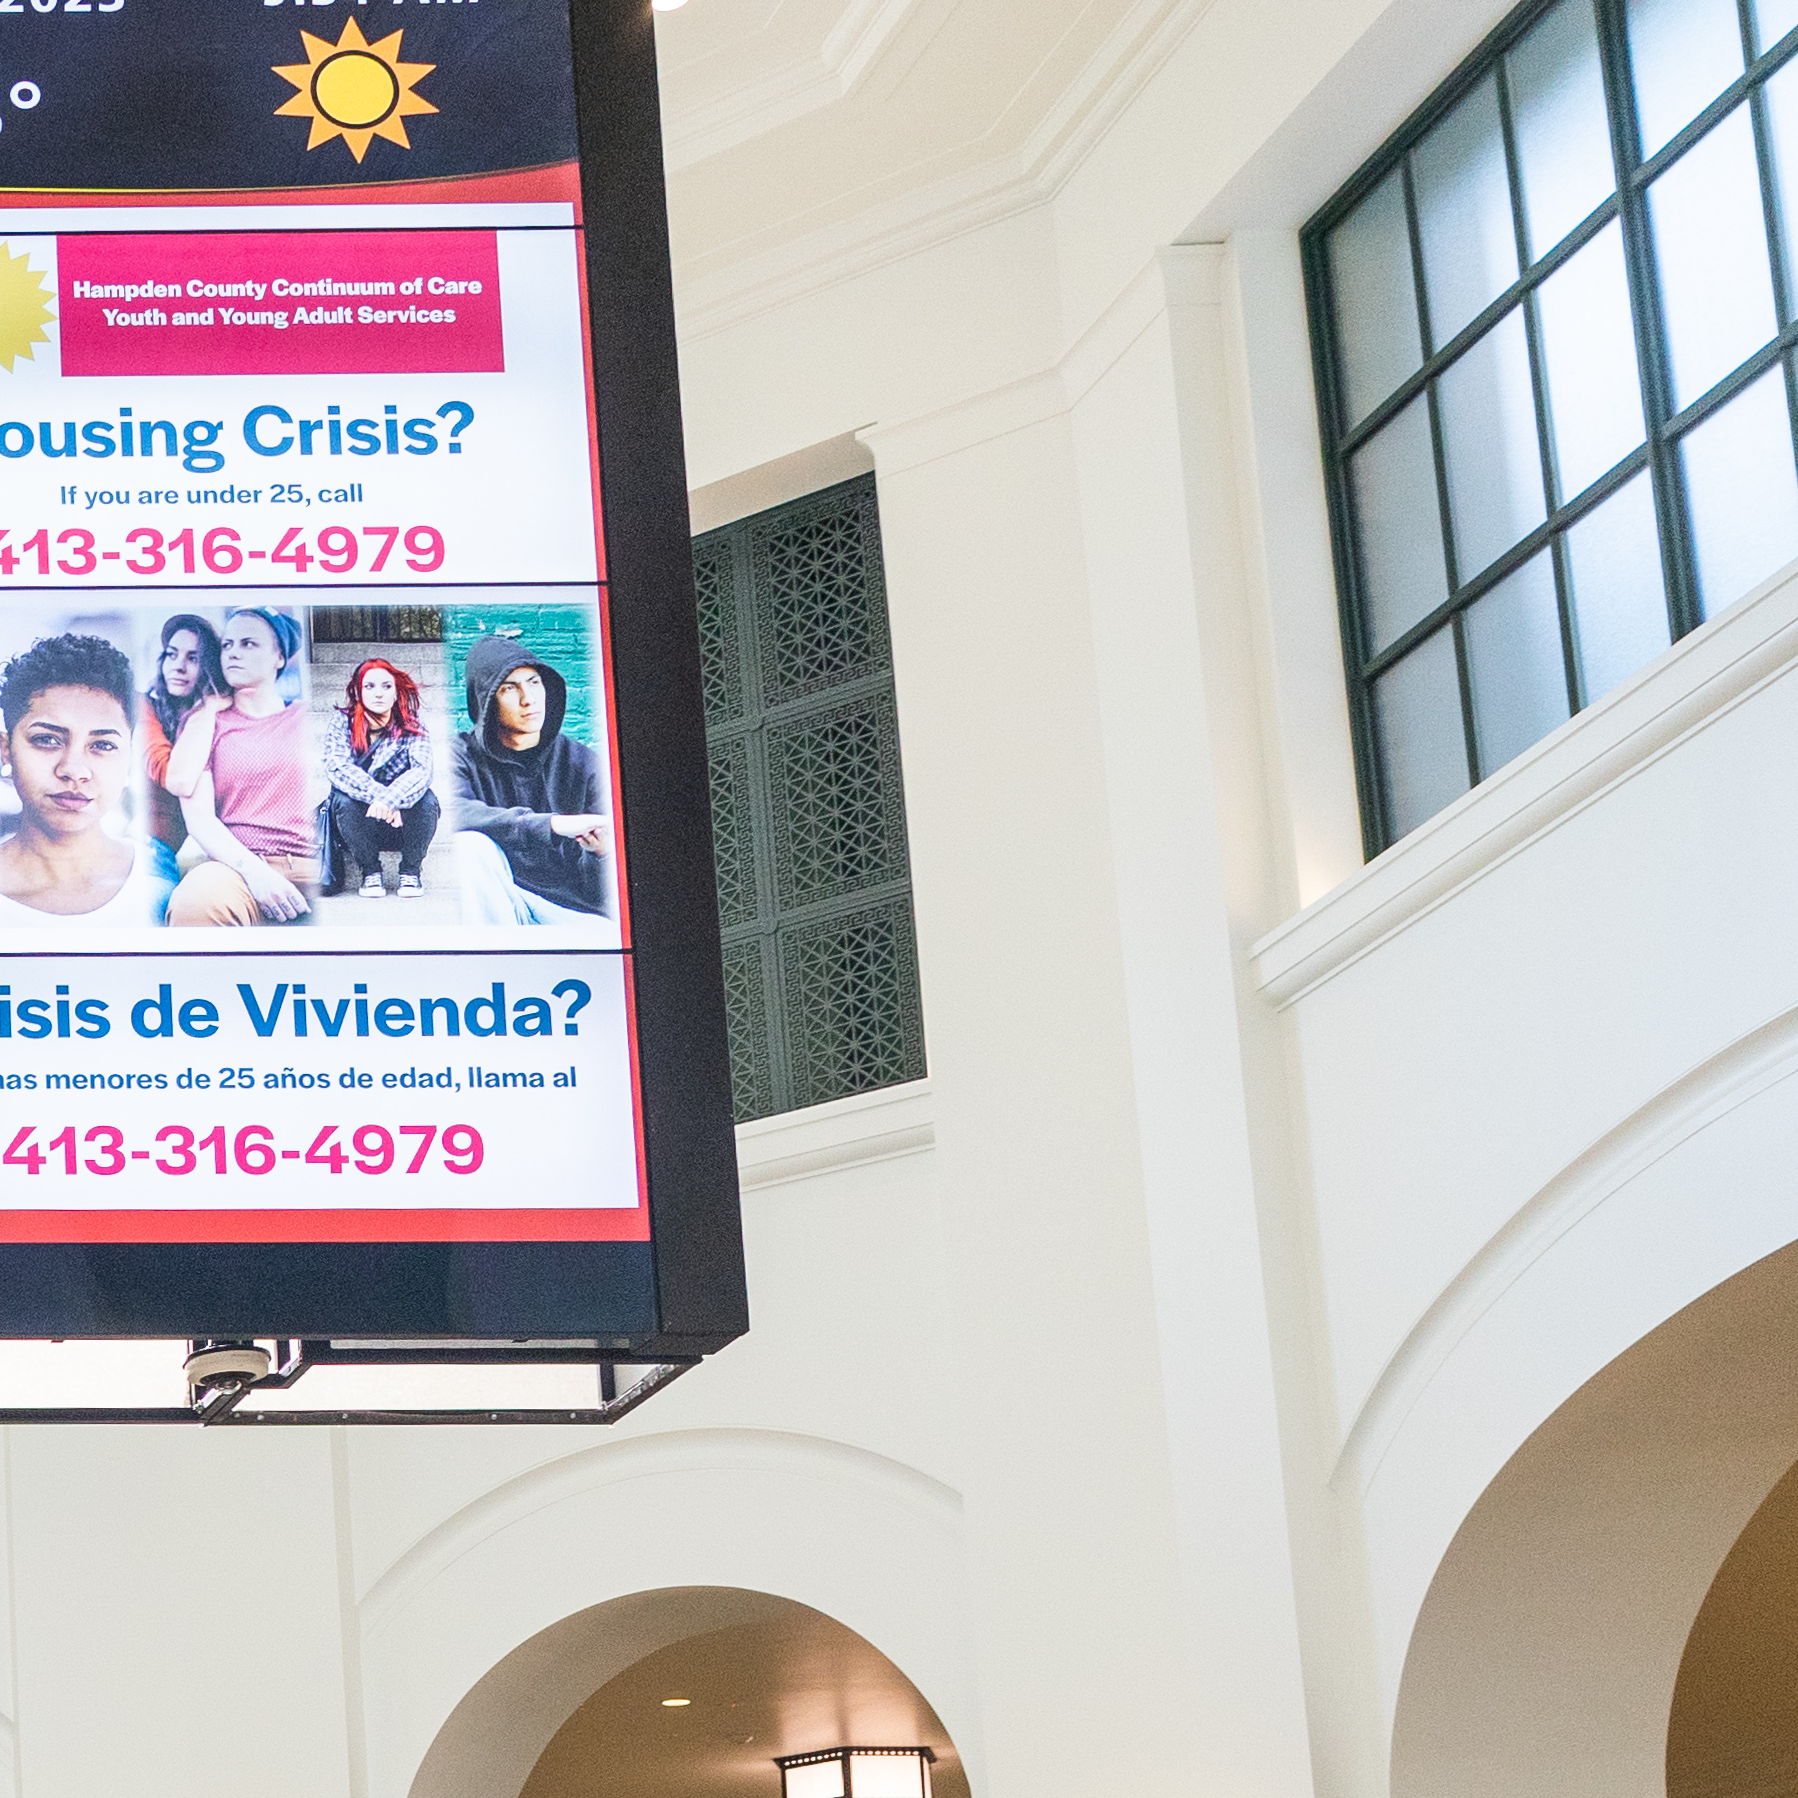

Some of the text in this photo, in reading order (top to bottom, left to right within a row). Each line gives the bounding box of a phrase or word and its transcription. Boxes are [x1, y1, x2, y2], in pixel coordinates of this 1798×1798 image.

[74, 277, 482, 301] Hampden County Continuum of Care
[102, 306, 456, 329] Youth and Young Adult Services
[243, 401, 474, 456] Crisis?
[61, 484, 362, 509] If you are under 25, call
[131, 984, 219, 1038] de
[236, 979, 591, 1037] Vivienda?
[46, 1074, 168, 1089] menores
[176, 1068, 210, 1089] de
[219, 1068, 255, 1088] 25
[264, 1067, 330, 1089] años
[339, 1067, 373, 1088] de
[382, 1067, 460, 1092] edad,
[469, 1067, 544, 1088] llama
[553, 1066, 576, 1087] al
[3, 1124, 484, 1175] 413-316-4979
